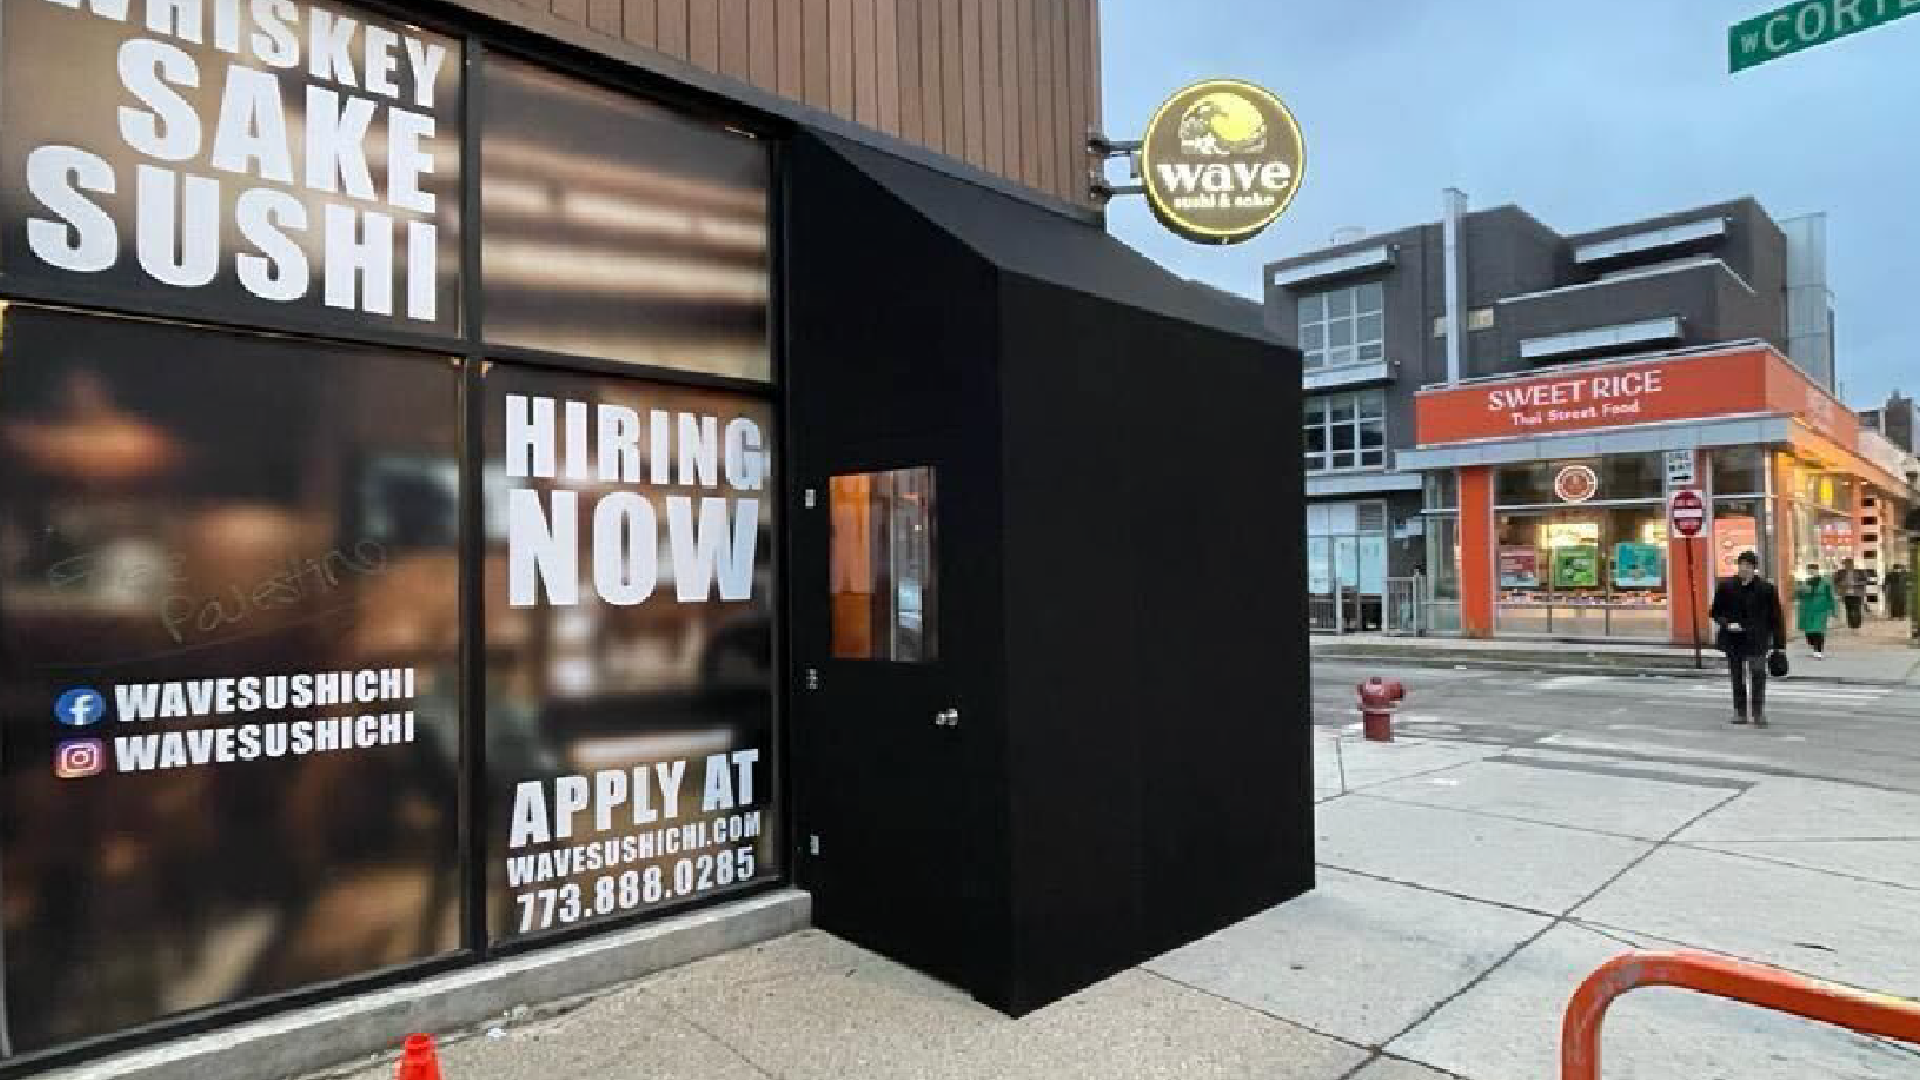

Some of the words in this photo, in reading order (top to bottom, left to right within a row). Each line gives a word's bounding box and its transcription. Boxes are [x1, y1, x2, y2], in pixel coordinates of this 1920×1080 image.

[44, 0, 446, 108] ISKEY
[1741, 31, 1759, 54] W
[1764, 0, 1920, 53] COR
[116, 37, 436, 214] SAKE
[1156, 160, 1292, 193] wave
[26, 144, 437, 322] SUSHI
[1488, 379, 1587, 411] SWEET
[1593, 369, 1663, 399] RICE
[1601, 398, 1641, 418] Food
[505, 393, 762, 491] HIRING
[508, 489, 760, 607] NOW
[114, 668, 415, 723] WAVESUSHICHI
[114, 710, 415, 773] WAVESUSHICHI
[509, 760, 687, 848] APPLY
[702, 748, 759, 813] AT
[506, 811, 761, 888] WAVESUSHICHI.COM
[516, 847, 756, 934] 773.888.0285
